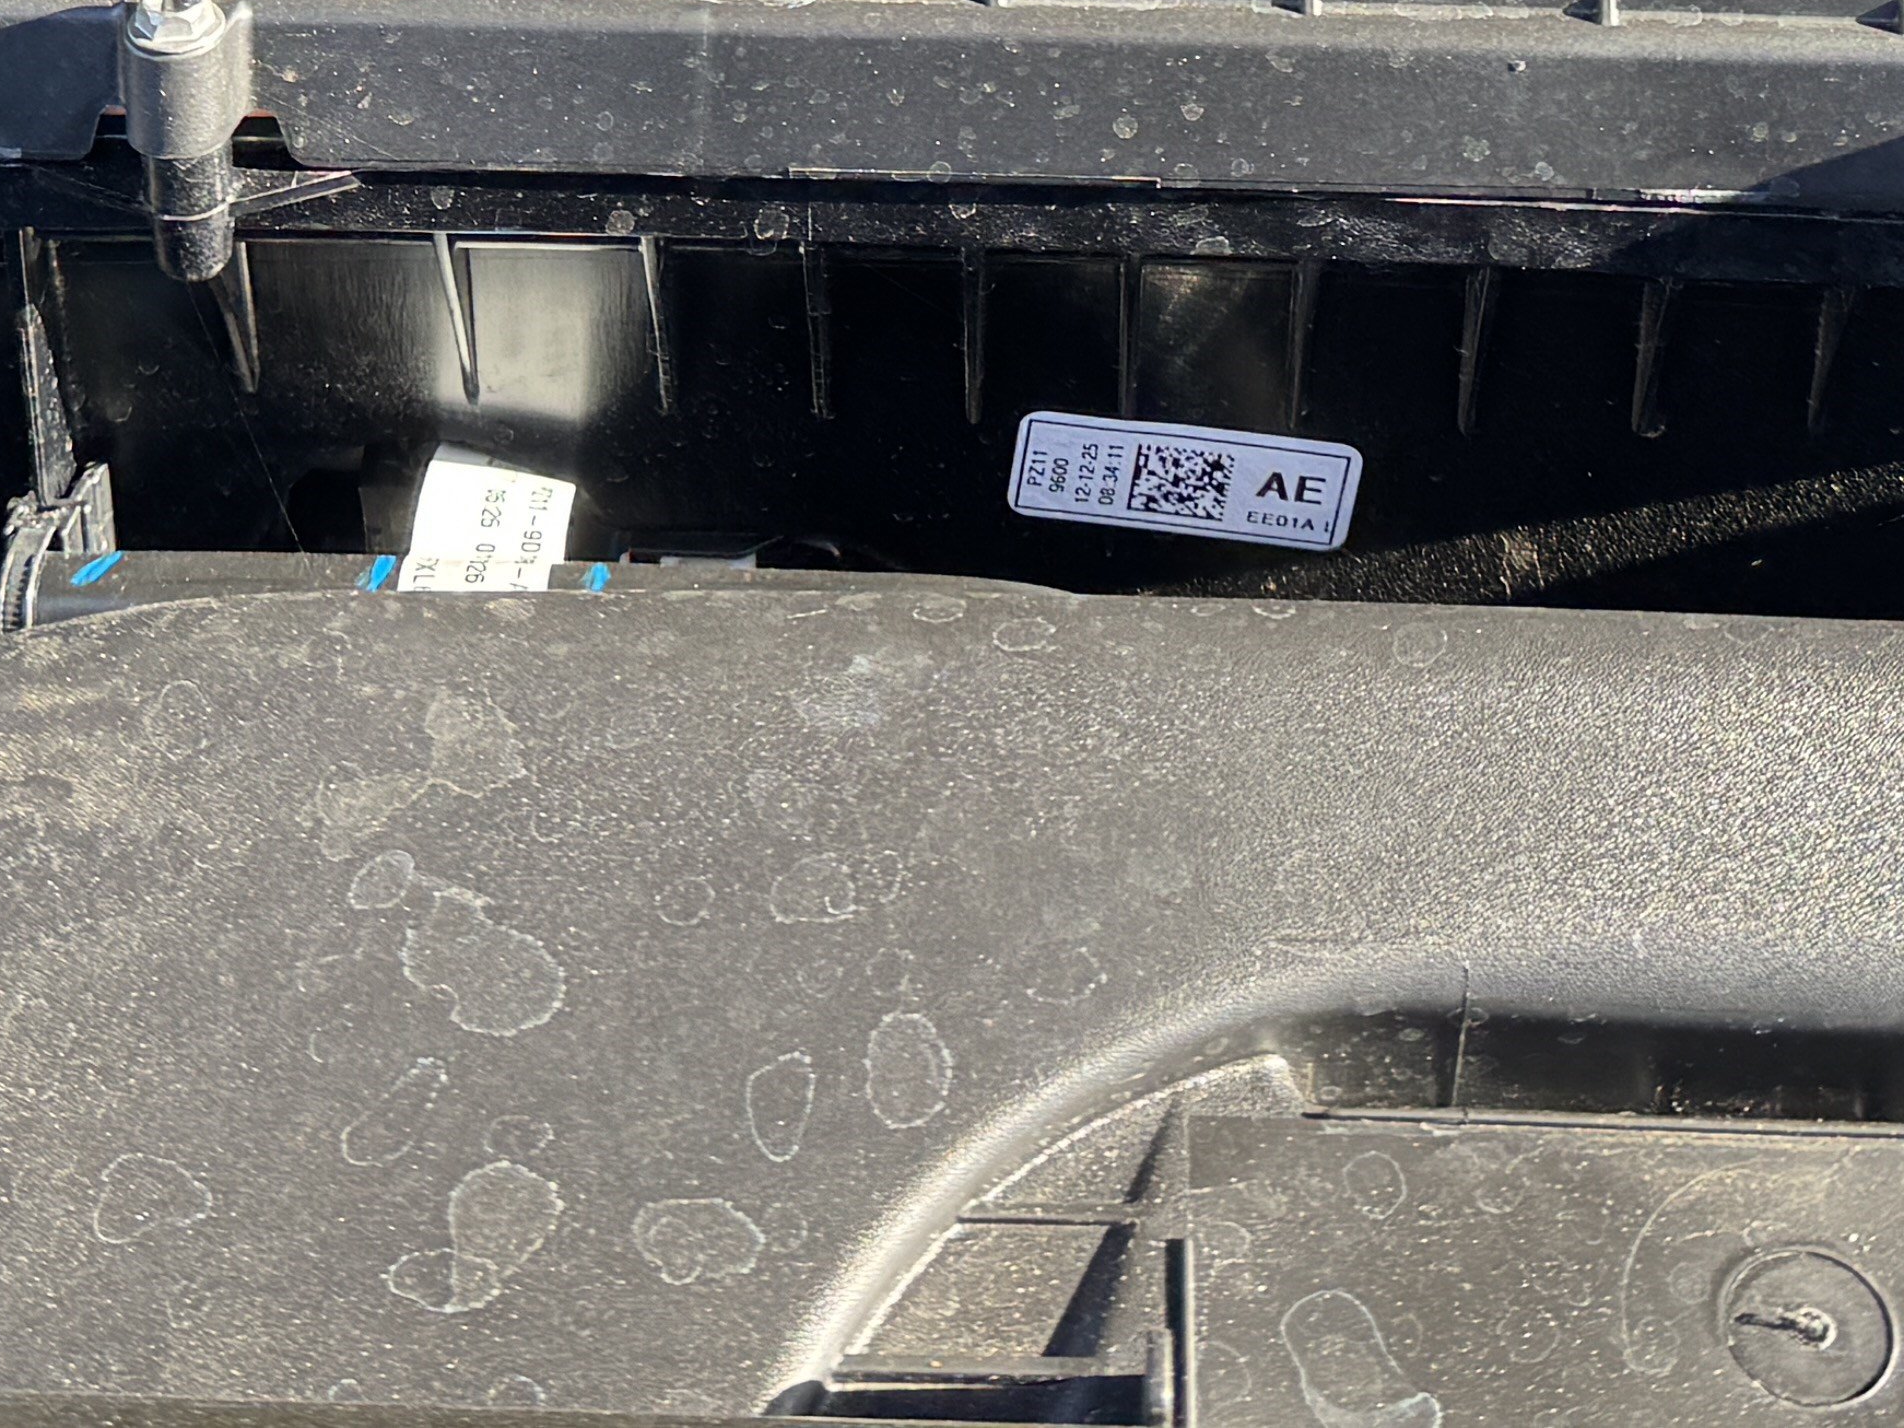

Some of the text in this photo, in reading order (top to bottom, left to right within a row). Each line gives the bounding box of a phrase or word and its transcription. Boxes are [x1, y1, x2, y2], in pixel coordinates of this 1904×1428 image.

[1026, 449, 1047, 487] PZ11
[1049, 457, 1070, 493] 9600
[1075, 442, 1099, 505] 12-12-25
[1098, 444, 1126, 506] 08:34:11
[1256, 471, 1326, 505] AE
[1246, 510, 1314, 531] EE01A
